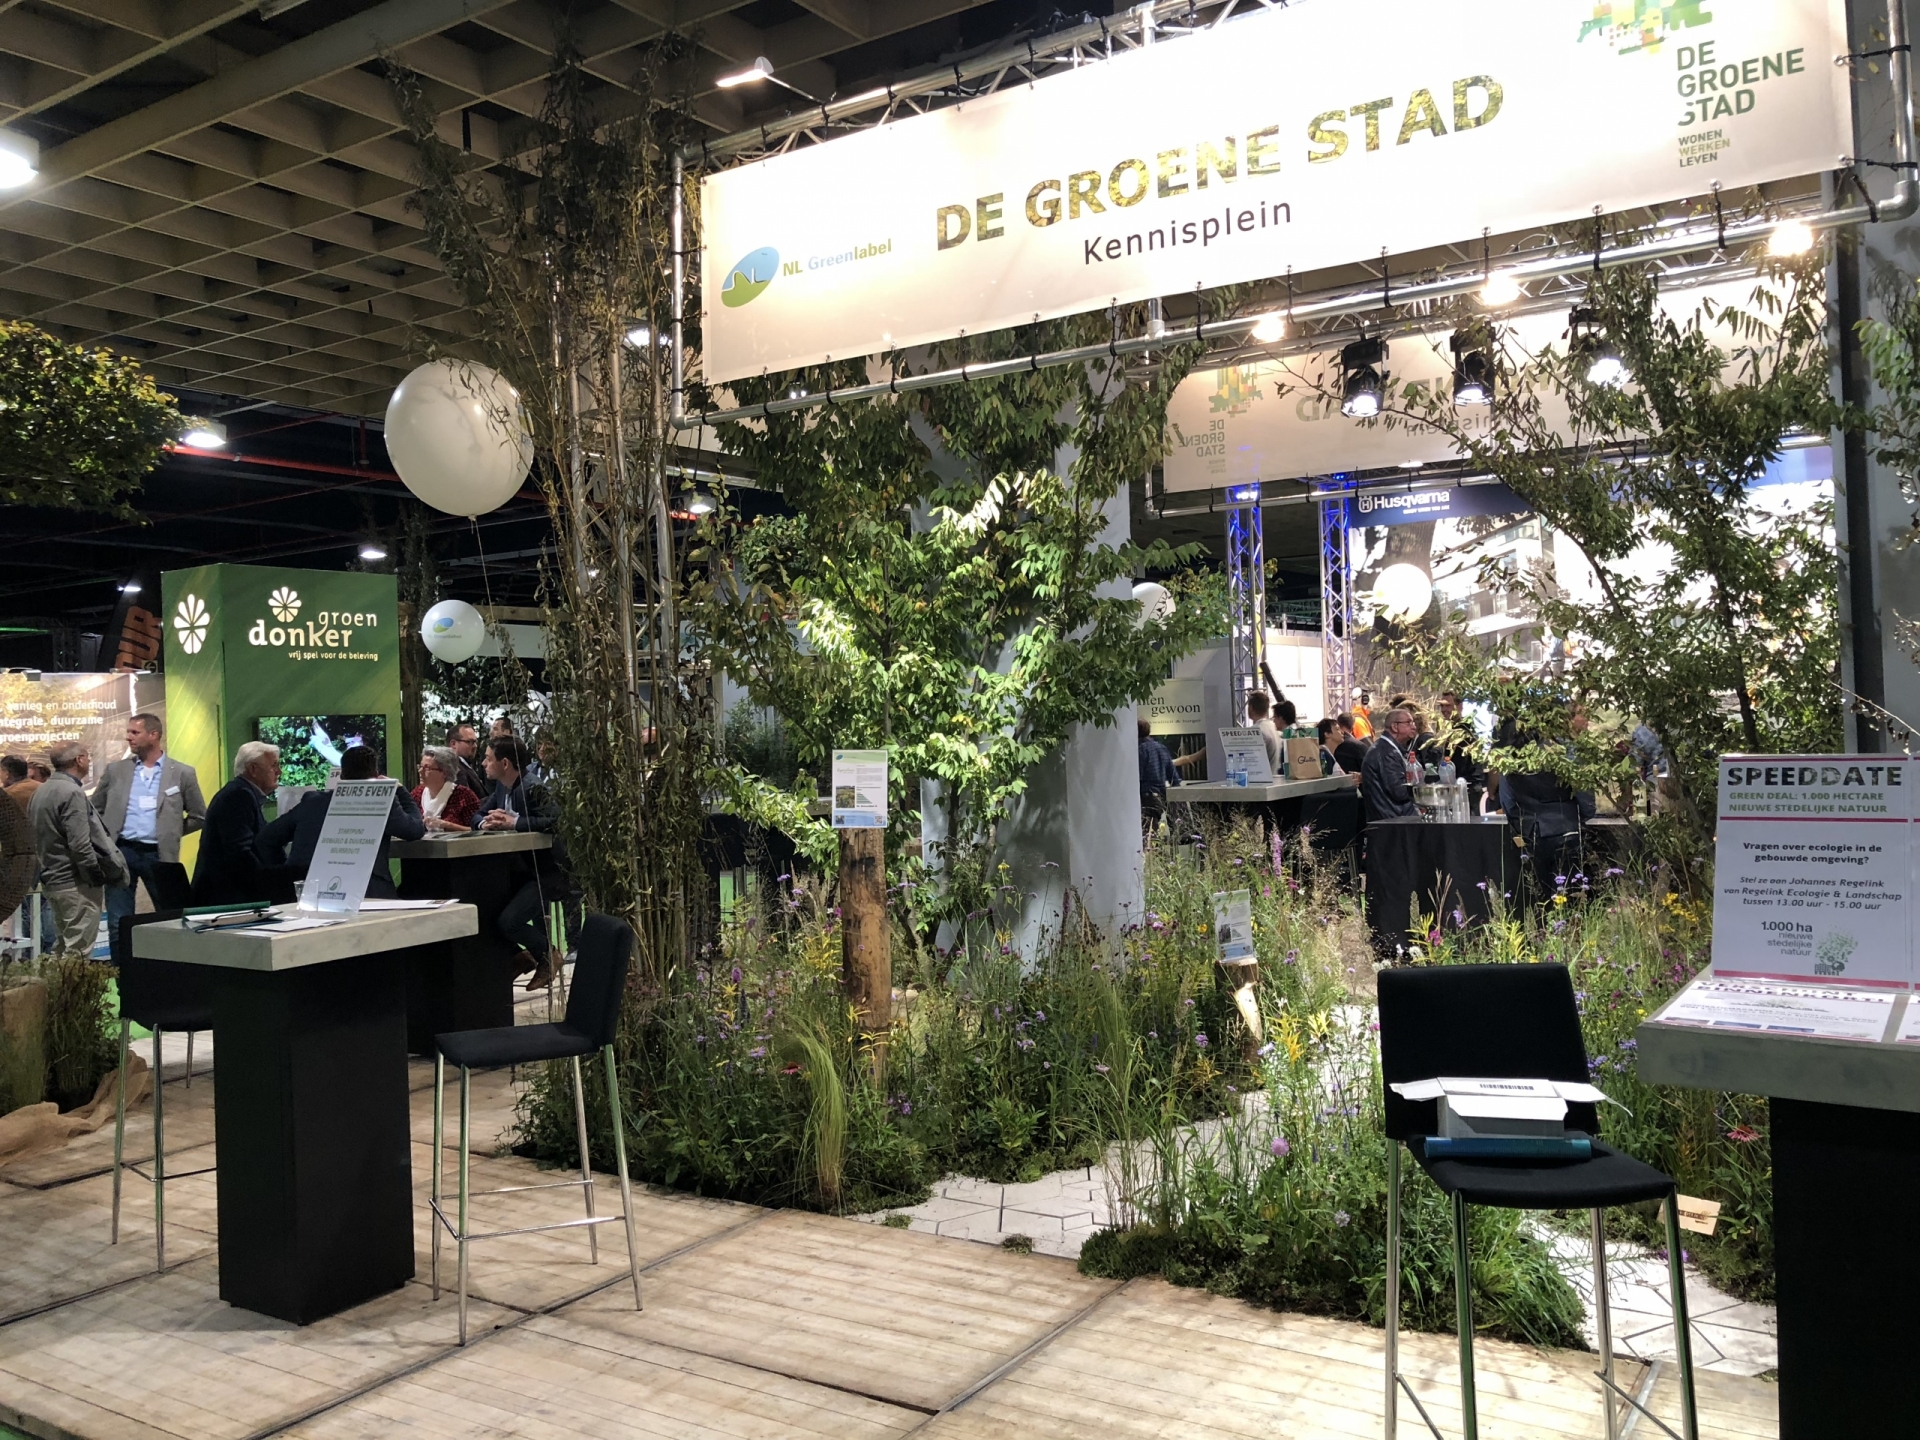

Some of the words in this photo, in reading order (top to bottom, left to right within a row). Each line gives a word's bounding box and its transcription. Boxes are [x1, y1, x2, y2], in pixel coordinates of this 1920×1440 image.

[1677, 40, 1716, 71] DE
[1677, 48, 1805, 97] GROENE
[1677, 89, 1755, 126] STAD
[1678, 129, 1722, 146] WONEN
[1678, 138, 1730, 156] WERKEN
[936, 193, 1004, 251] DE
[1025, 124, 1281, 228] GROENE
[1307, 75, 1504, 164] STAD
[1679, 152, 1718, 168] LEVEN
[1085, 201, 1293, 266] Kennisplein
[783, 260, 803, 276] NL
[808, 238, 892, 270] Greenlabel
[1374, 491, 1450, 510] Husqvarna
[318, 611, 378, 628] groen
[248, 619, 352, 648] donker
[288, 650, 301, 661] vrij
[303, 651, 319, 661] spel
[320, 652, 336, 660] voor
[338, 651, 347, 660] de
[349, 652, 379, 662] beleving
[6, 700, 43, 712] aanleg
[46, 702, 58, 710] en
[62, 699, 117, 710] onderhoud
[1151, 704, 1200, 717] gewoon
[51, 716, 103, 725] duurzame
[1727, 766, 1902, 786] SPEEDDATE
[335, 786, 364, 797] BEURS
[365, 786, 395, 797] EVENT
[1729, 791, 1765, 800] GREEN
[1767, 792, 1798, 800] DEAL:
[1801, 792, 1830, 800] 1.000
[1833, 792, 1884, 801] HECTARE
[1729, 804, 1772, 812] NIEUWE
[1774, 804, 1836, 814] STEDELIJKE
[1838, 804, 1888, 813] NATUUR
[1743, 842, 1779, 852] Vragen
[1808, 843, 1853, 854] ecologie
[1855, 844, 1866, 852] in
[1868, 844, 1882, 852] de
[1754, 854, 1808, 863] gebouwde
[1811, 856, 1870, 866] omgeving?
[1788, 877, 1837, 886] Johannes
[1839, 878, 1884, 889] Regelink
[1741, 887, 1784, 897] Regelink
[1786, 888, 1831, 899] Ecologie
[1833, 890, 1841, 898] &
[1846, 891, 1902, 902] Landschap
[1743, 897, 1773, 906] tussen
[1777, 898, 1804, 907] 13.00
[1806, 900, 1824, 908] uur
[1833, 901, 1862, 910] 15.00
[1865, 902, 1882, 910] uur
[1761, 921, 1794, 932] 1.000
[1796, 921, 1813, 933] ha
[1778, 932, 1813, 941] nieuwe
[1767, 939, 1812, 950] stedelijke
[1780, 948, 1811, 956] natuur
